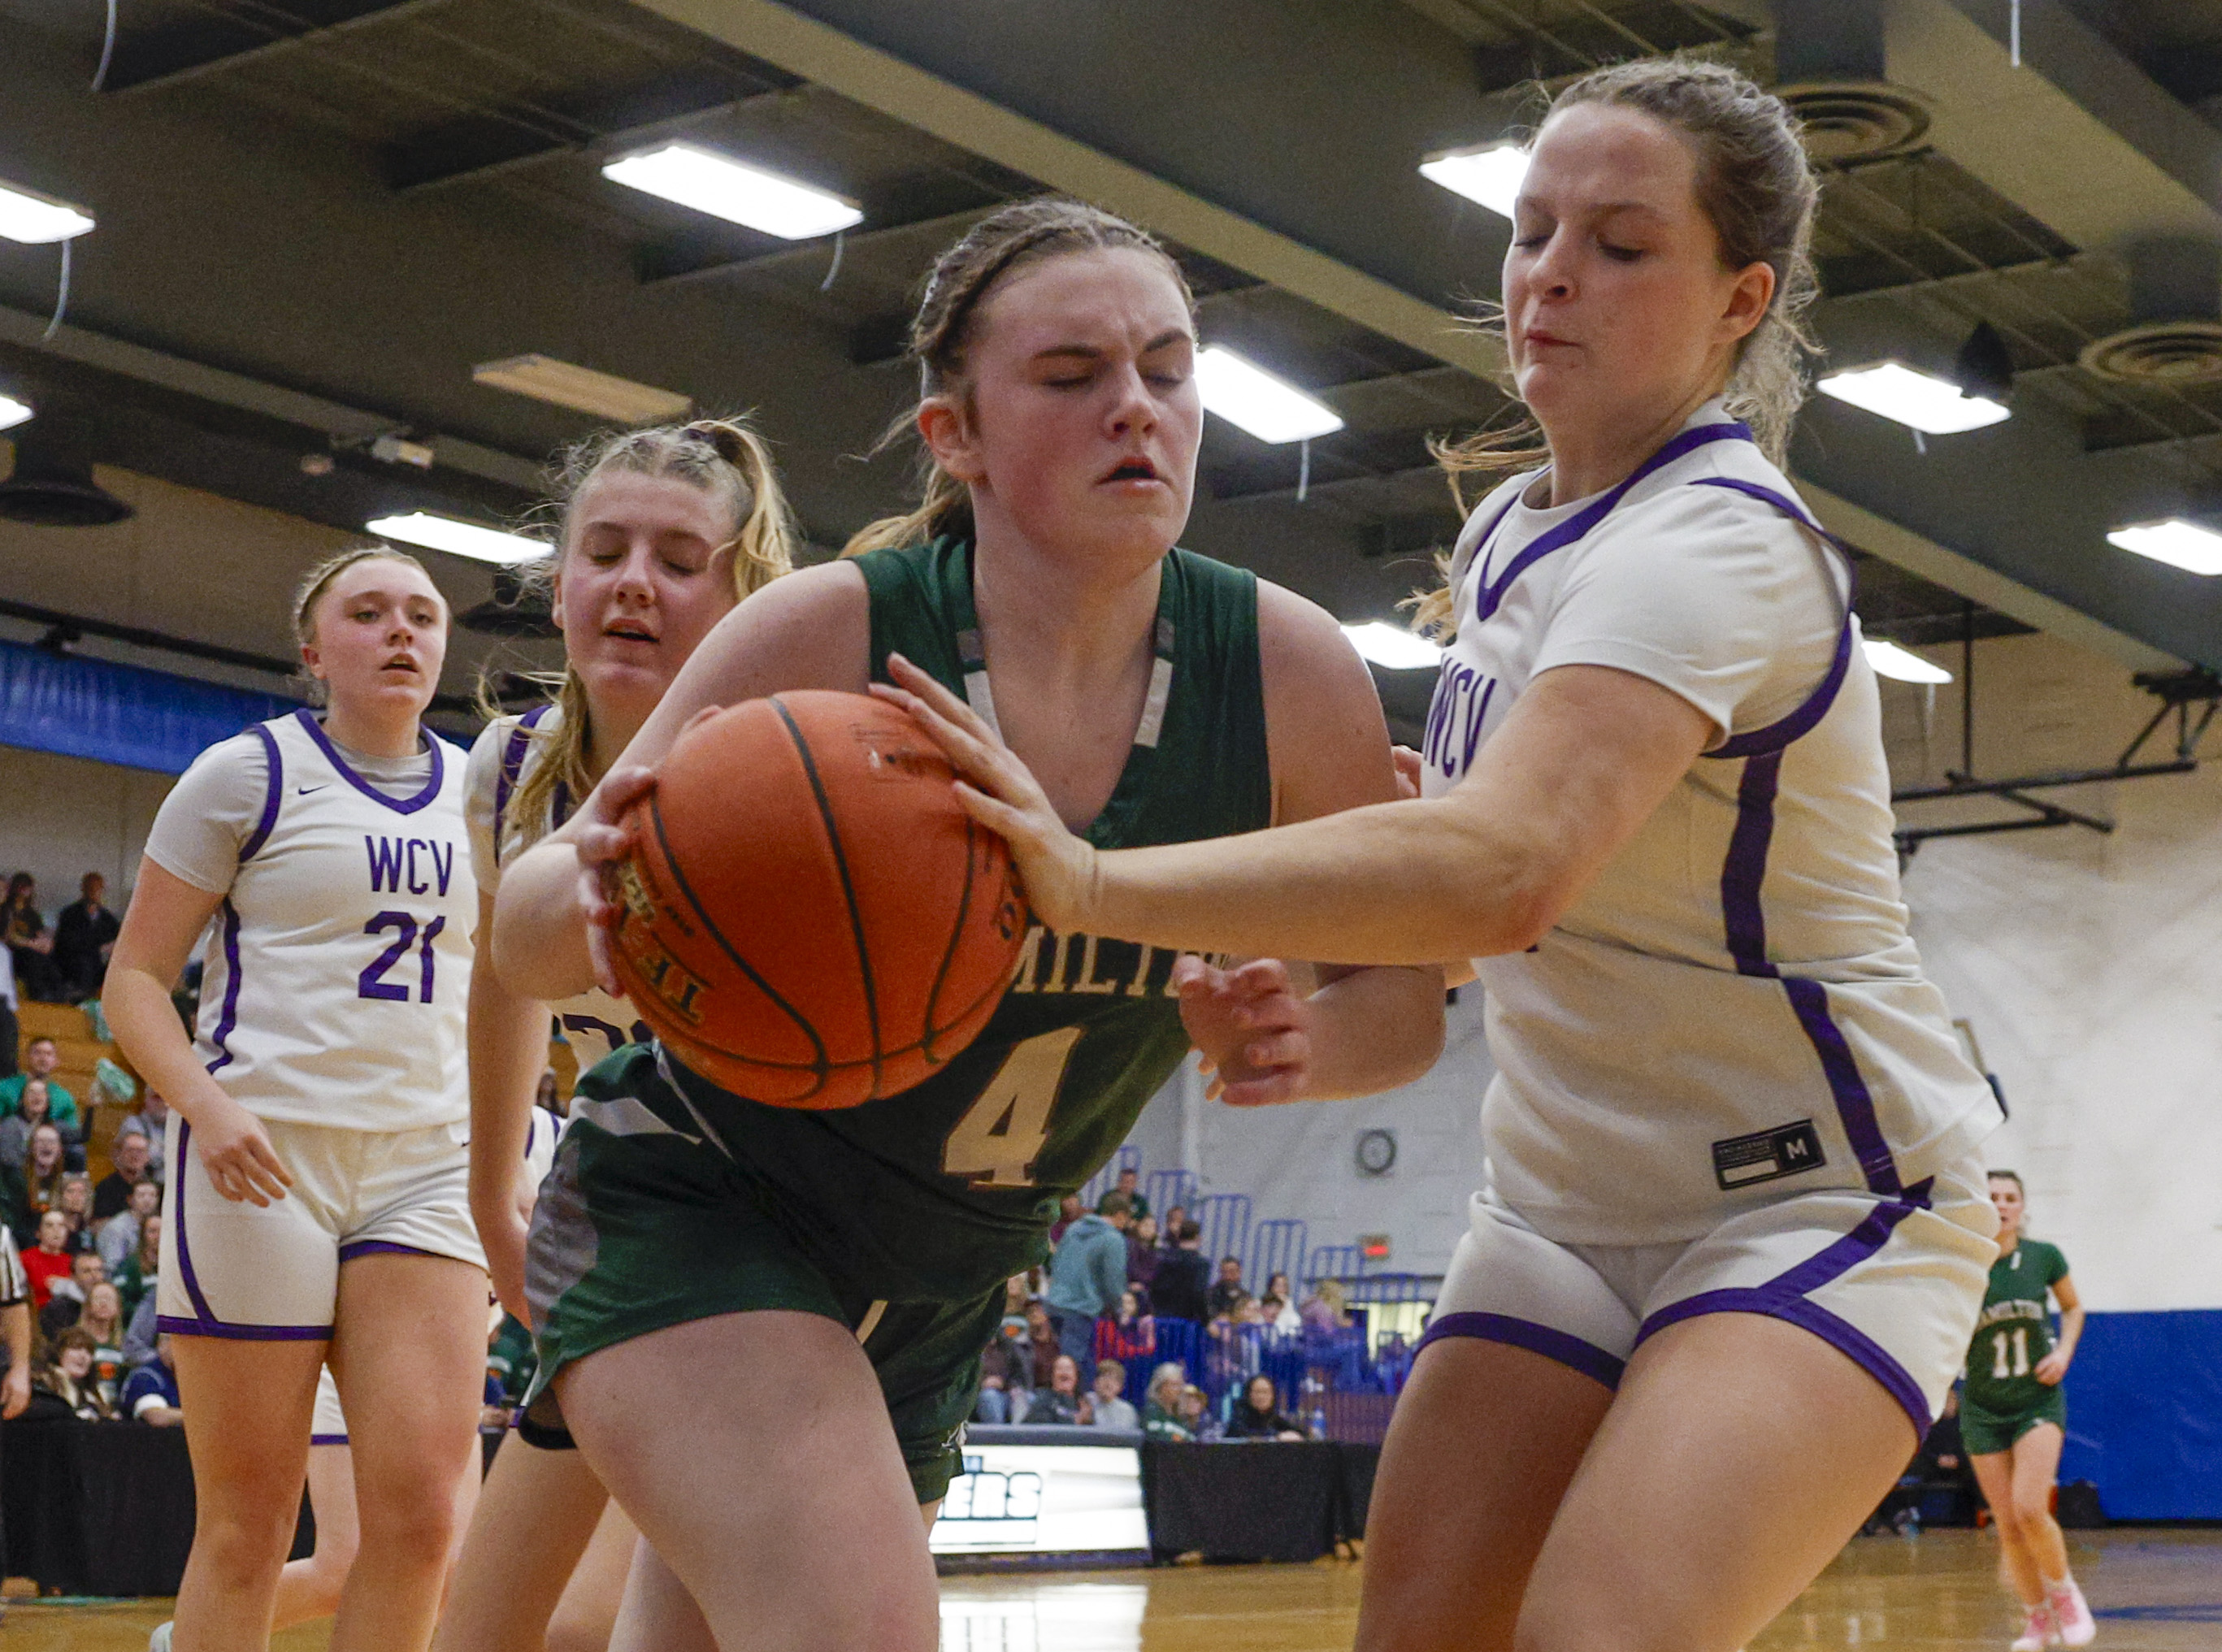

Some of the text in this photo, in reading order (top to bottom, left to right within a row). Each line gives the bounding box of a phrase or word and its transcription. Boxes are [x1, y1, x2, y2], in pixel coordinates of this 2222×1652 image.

[365, 835, 452, 897] WCV
[358, 911, 446, 1004] 21
[943, 1025, 1085, 1187] 4
[1785, 1138, 1809, 1160] M
[1992, 1326, 2030, 1379] 11
[937, 1471, 1042, 1521] ERS
